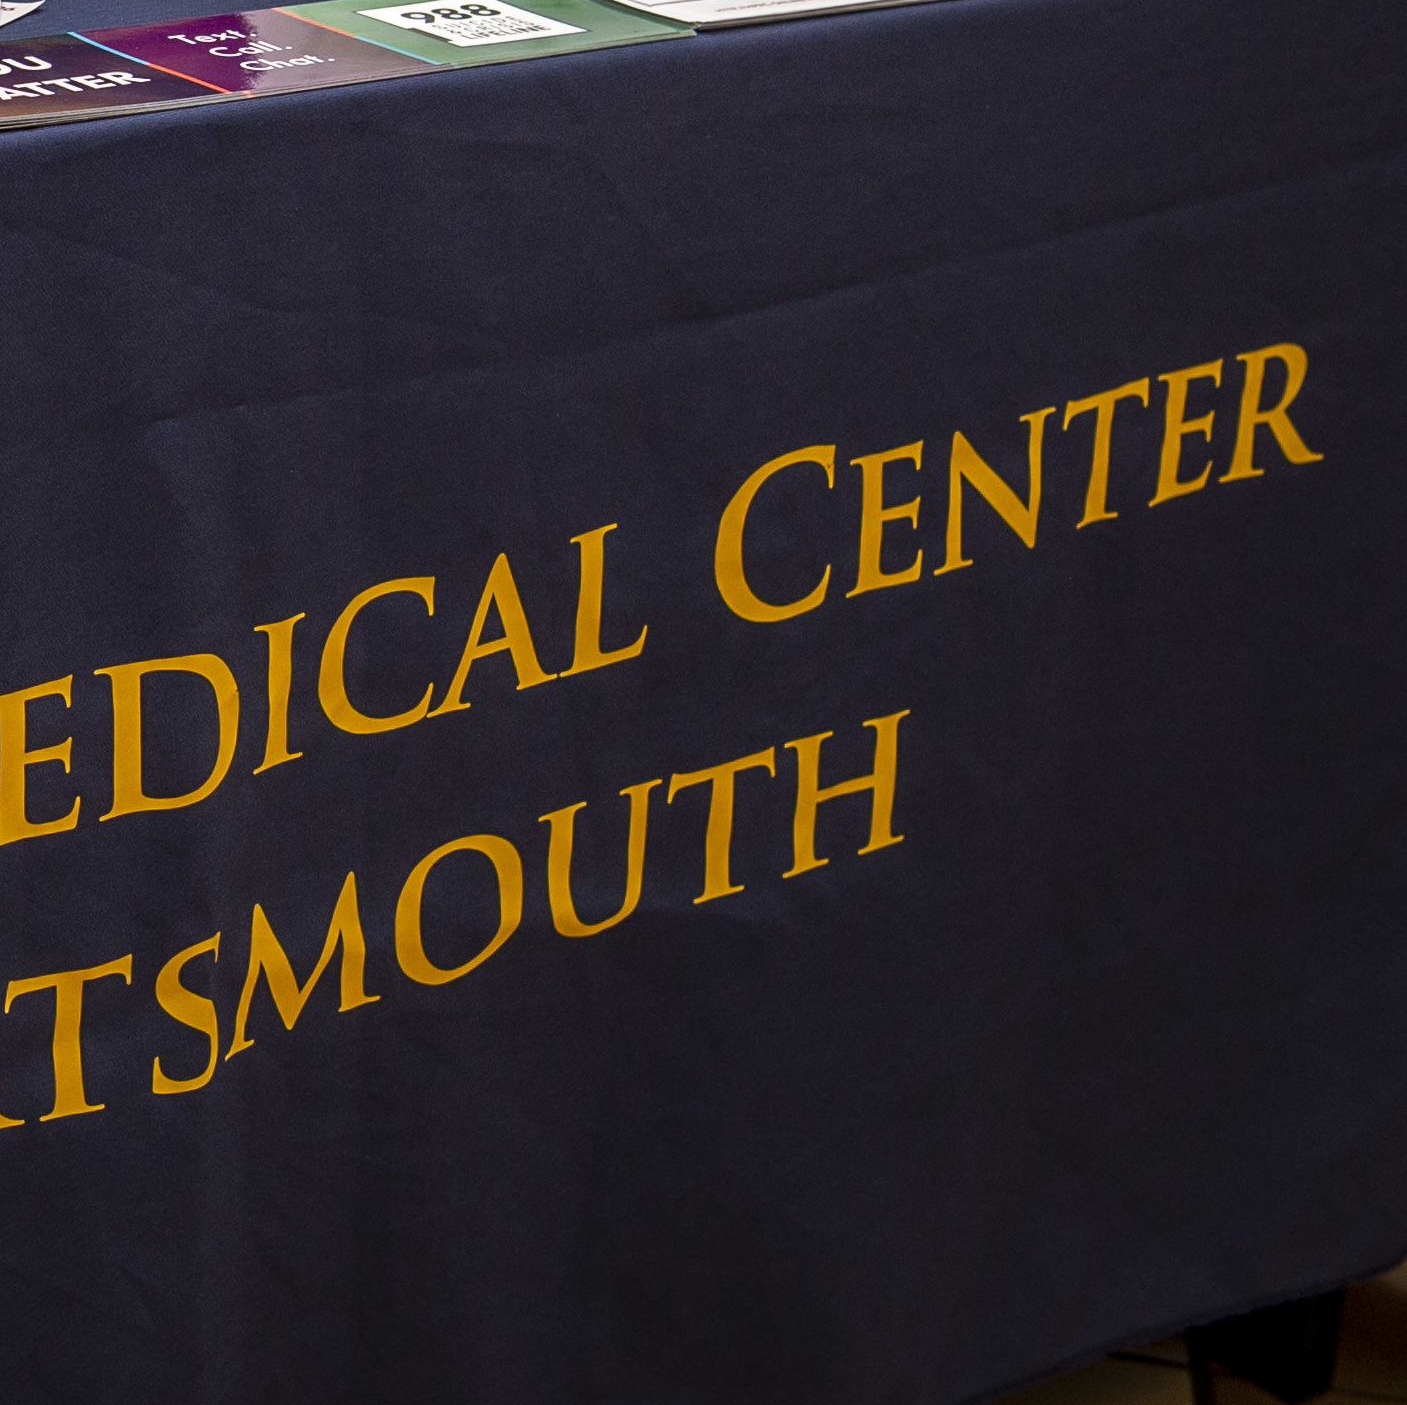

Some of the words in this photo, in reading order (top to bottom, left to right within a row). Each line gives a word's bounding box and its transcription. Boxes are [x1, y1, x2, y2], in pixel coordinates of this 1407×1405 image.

[400, 3, 502, 24] 988
[166, 27, 258, 48] Text.
[459, 24, 552, 41] LIFELINE
[206, 39, 293, 60] Call.
[237, 53, 335, 75] Chat.
[713, 342, 1324, 623] CENTER
